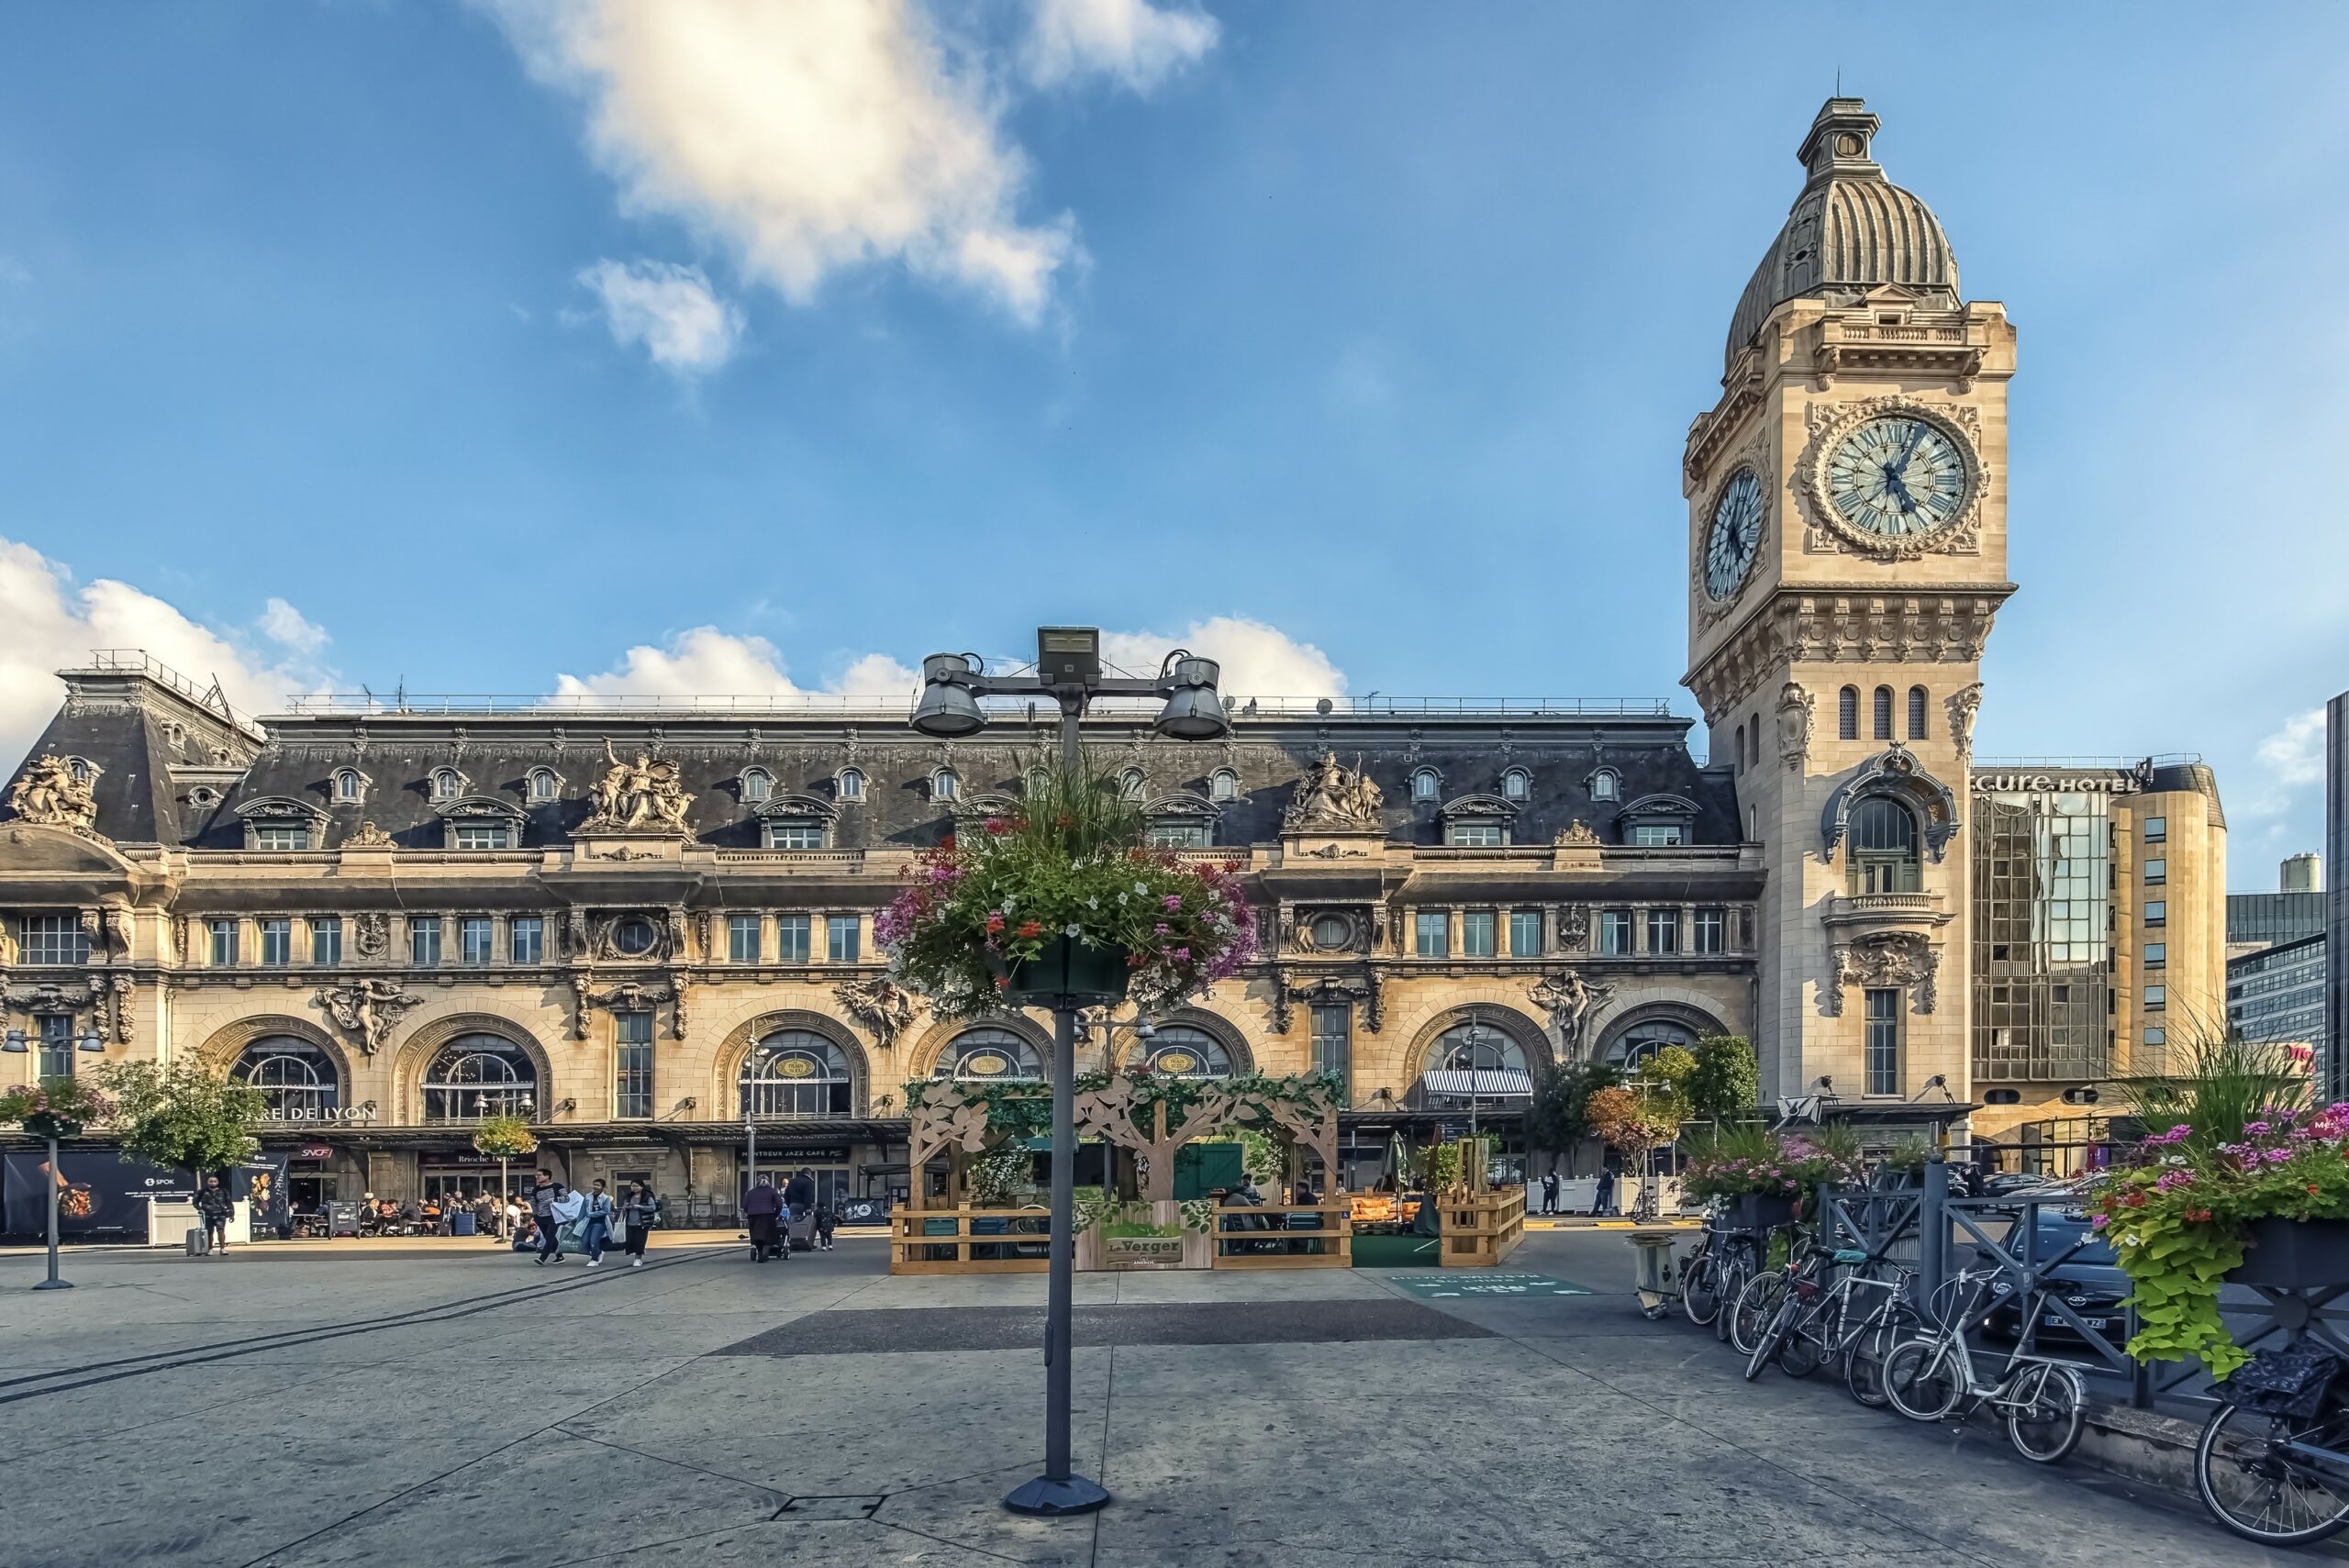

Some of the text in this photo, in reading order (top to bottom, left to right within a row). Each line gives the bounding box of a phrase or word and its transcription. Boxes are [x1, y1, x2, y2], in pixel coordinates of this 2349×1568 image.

[1887, 424, 1903, 444] XII
[1935, 474, 1957, 485] III
[1970, 774, 2054, 792] cure
[291, 1107, 316, 1120] DE
[325, 1106, 376, 1120] LYON
[301, 1149, 330, 1157] SNCF
[492, 1154, 517, 1162] Dée
[1121, 1240, 1179, 1254] Verger
